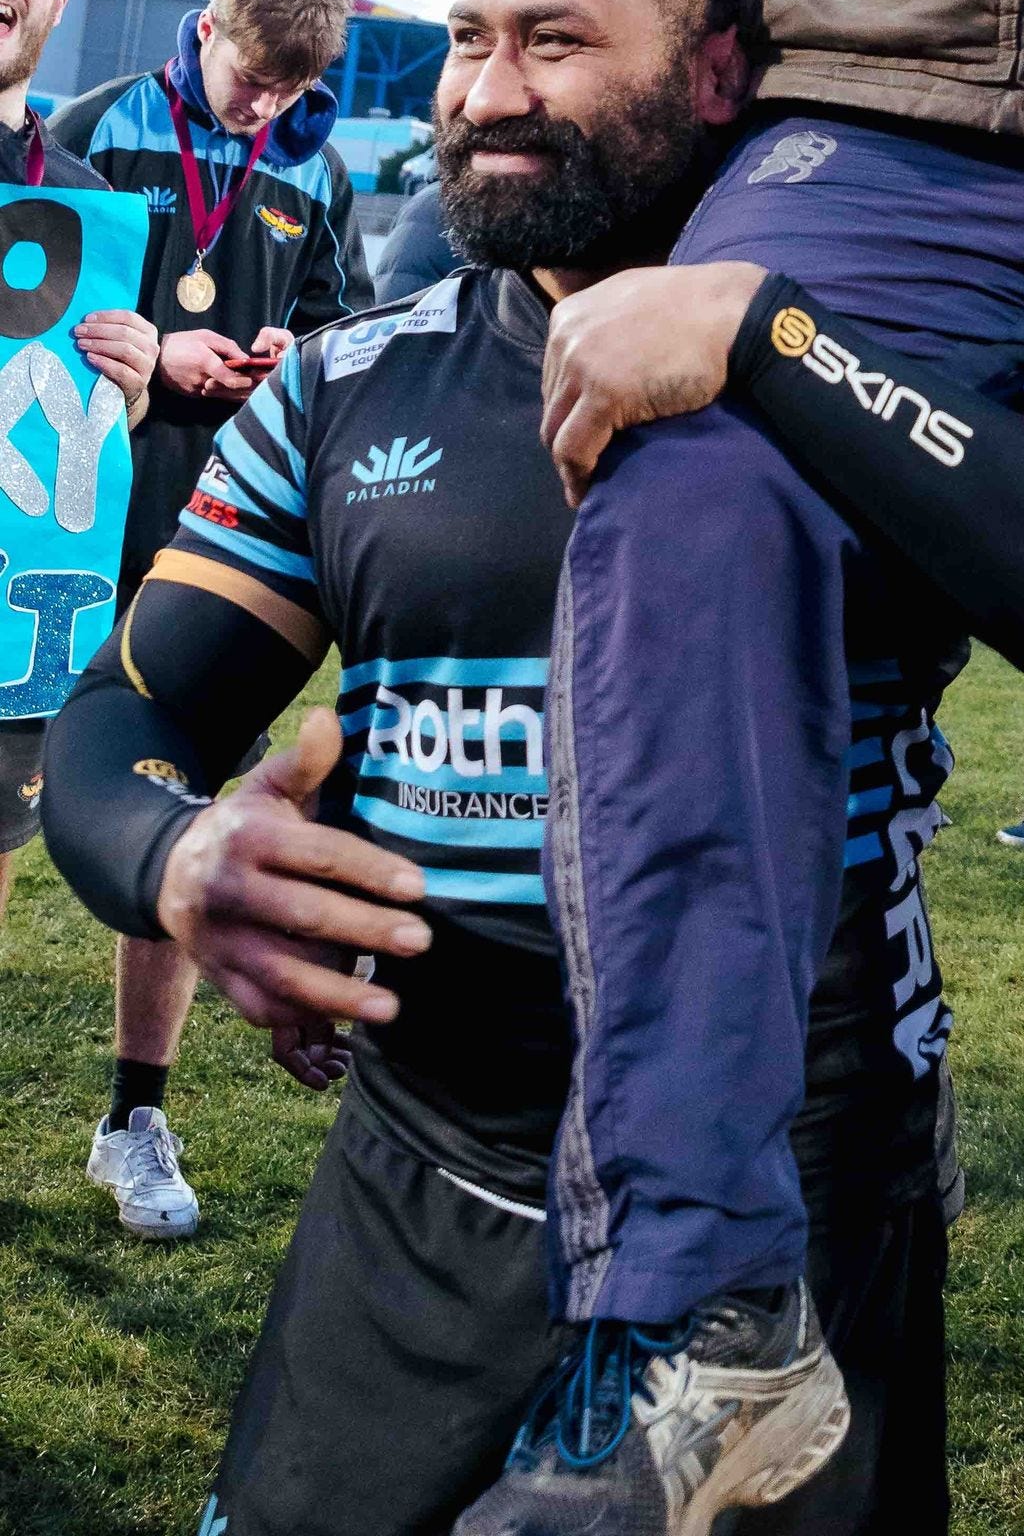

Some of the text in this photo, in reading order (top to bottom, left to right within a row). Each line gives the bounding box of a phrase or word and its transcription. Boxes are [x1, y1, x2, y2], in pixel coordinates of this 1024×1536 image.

[346, 478, 436, 505] PALADIN
[368, 685, 543, 777] Roth
[400, 782, 550, 819] INSURANCE
